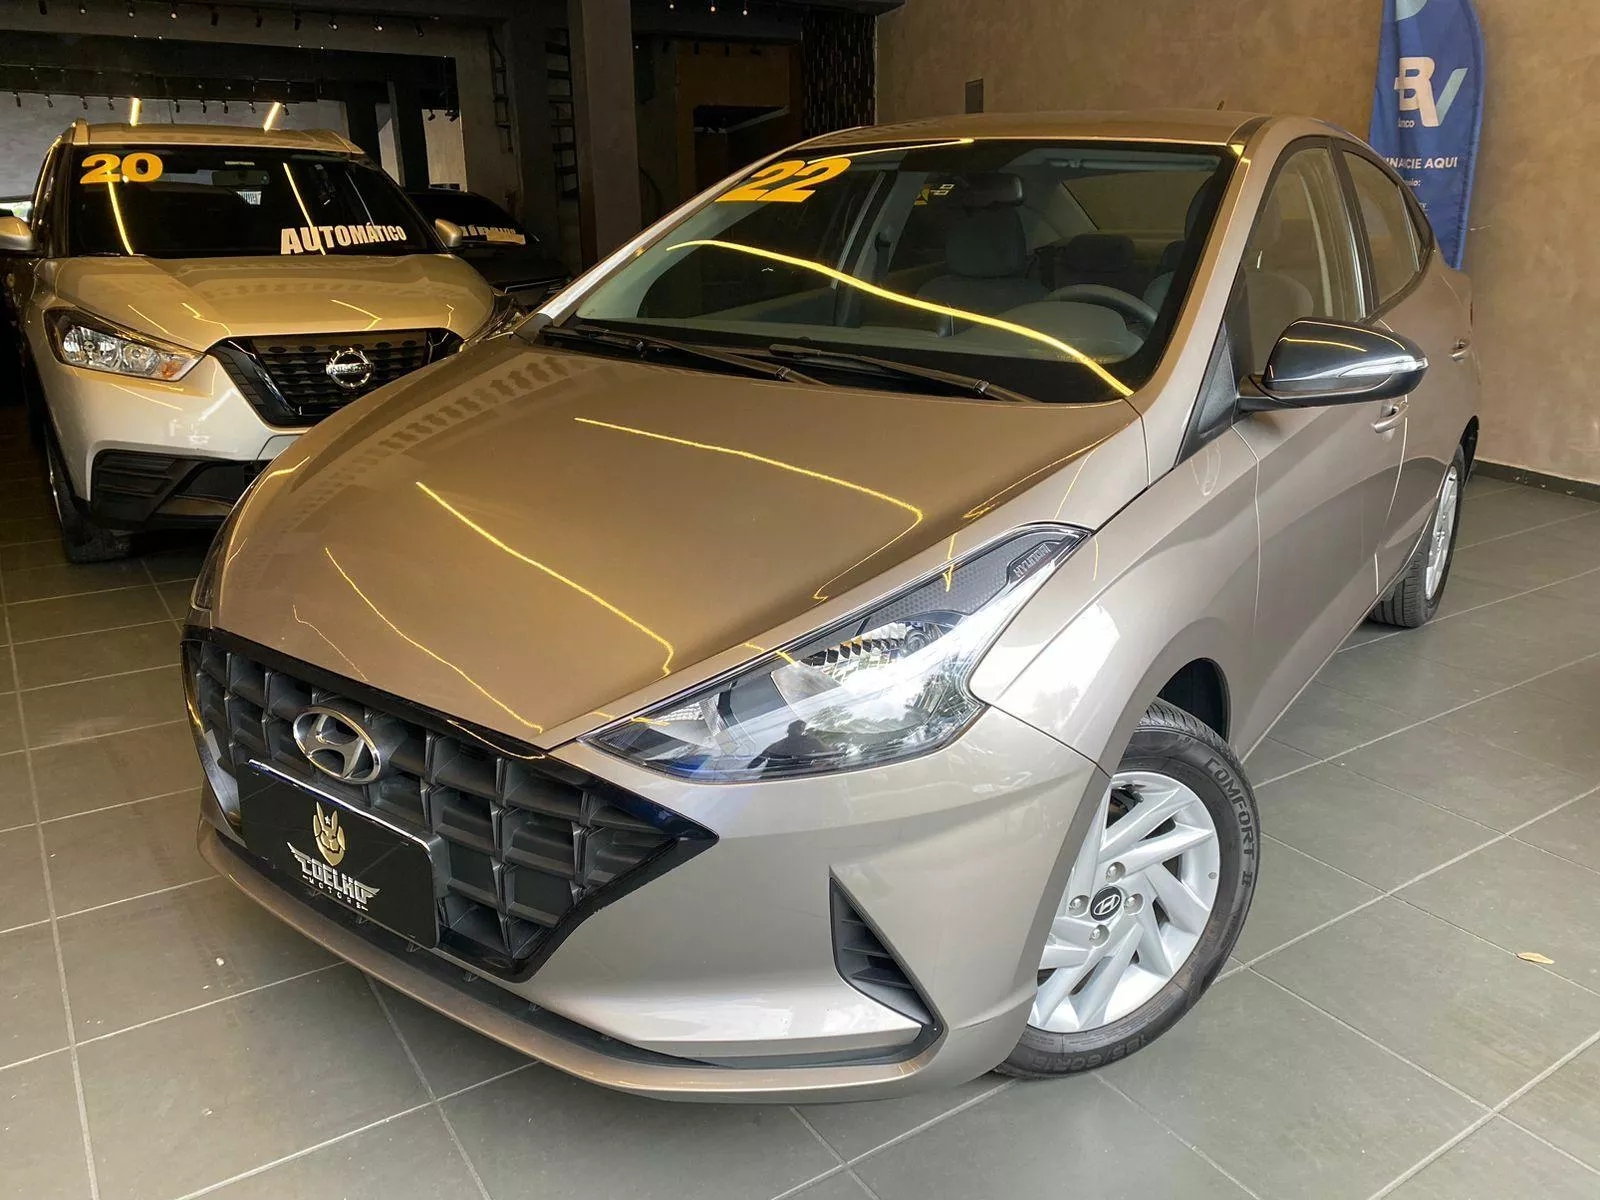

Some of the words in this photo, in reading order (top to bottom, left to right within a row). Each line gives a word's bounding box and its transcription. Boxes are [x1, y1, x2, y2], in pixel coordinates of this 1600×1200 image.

[79, 152, 164, 184] 20
[714, 156, 852, 203] 22
[1424, 156, 1458, 170] AQUI
[279, 221, 407, 255] AUTOMÁTICO
[1204, 757, 1256, 860] COMFORT
[293, 850, 376, 904] COELHO
